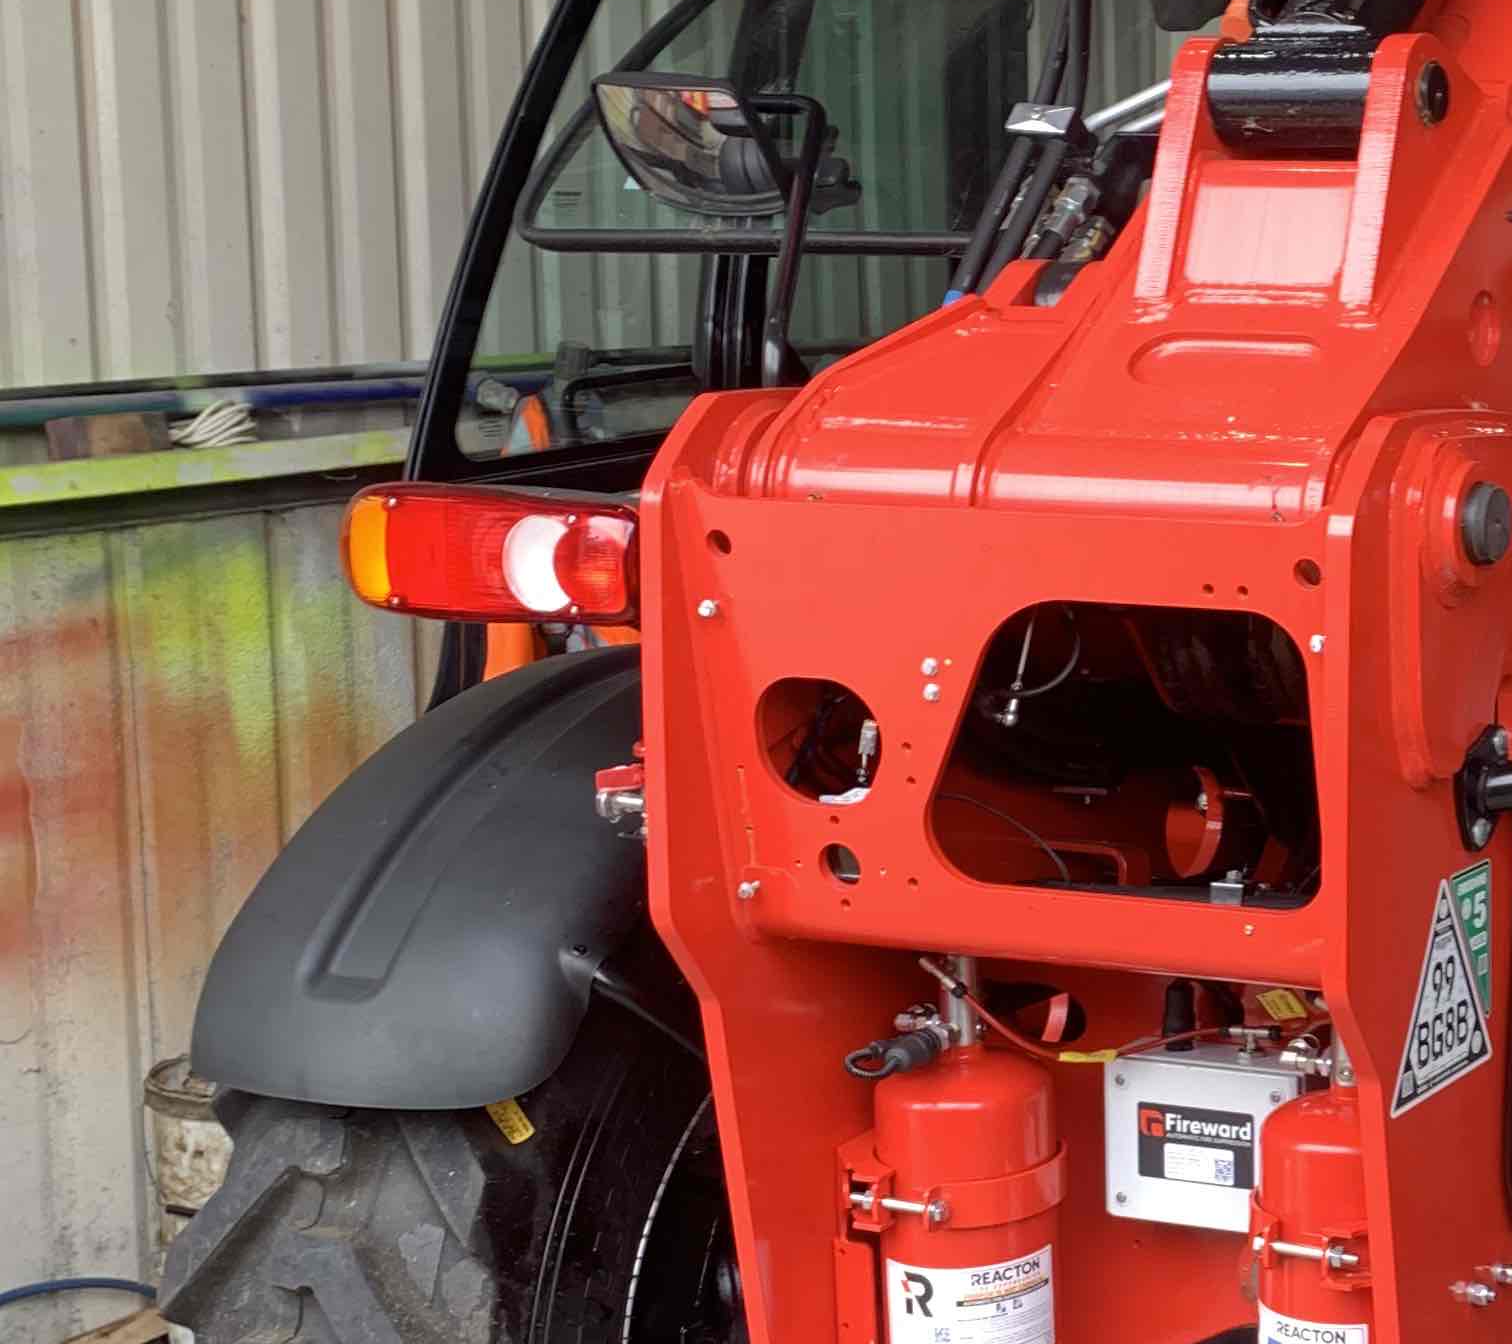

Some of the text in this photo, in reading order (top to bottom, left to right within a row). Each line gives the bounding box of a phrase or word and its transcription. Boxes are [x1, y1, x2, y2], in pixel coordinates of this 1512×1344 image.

[1472, 890, 1487, 929] 5
[1432, 955, 1455, 1010] 99
[1418, 999, 1469, 1069] BG8B
[1164, 1112, 1252, 1142] Fireward
[970, 1256, 1041, 1287] REACTON
[1276, 1320, 1346, 1344] REACTON
